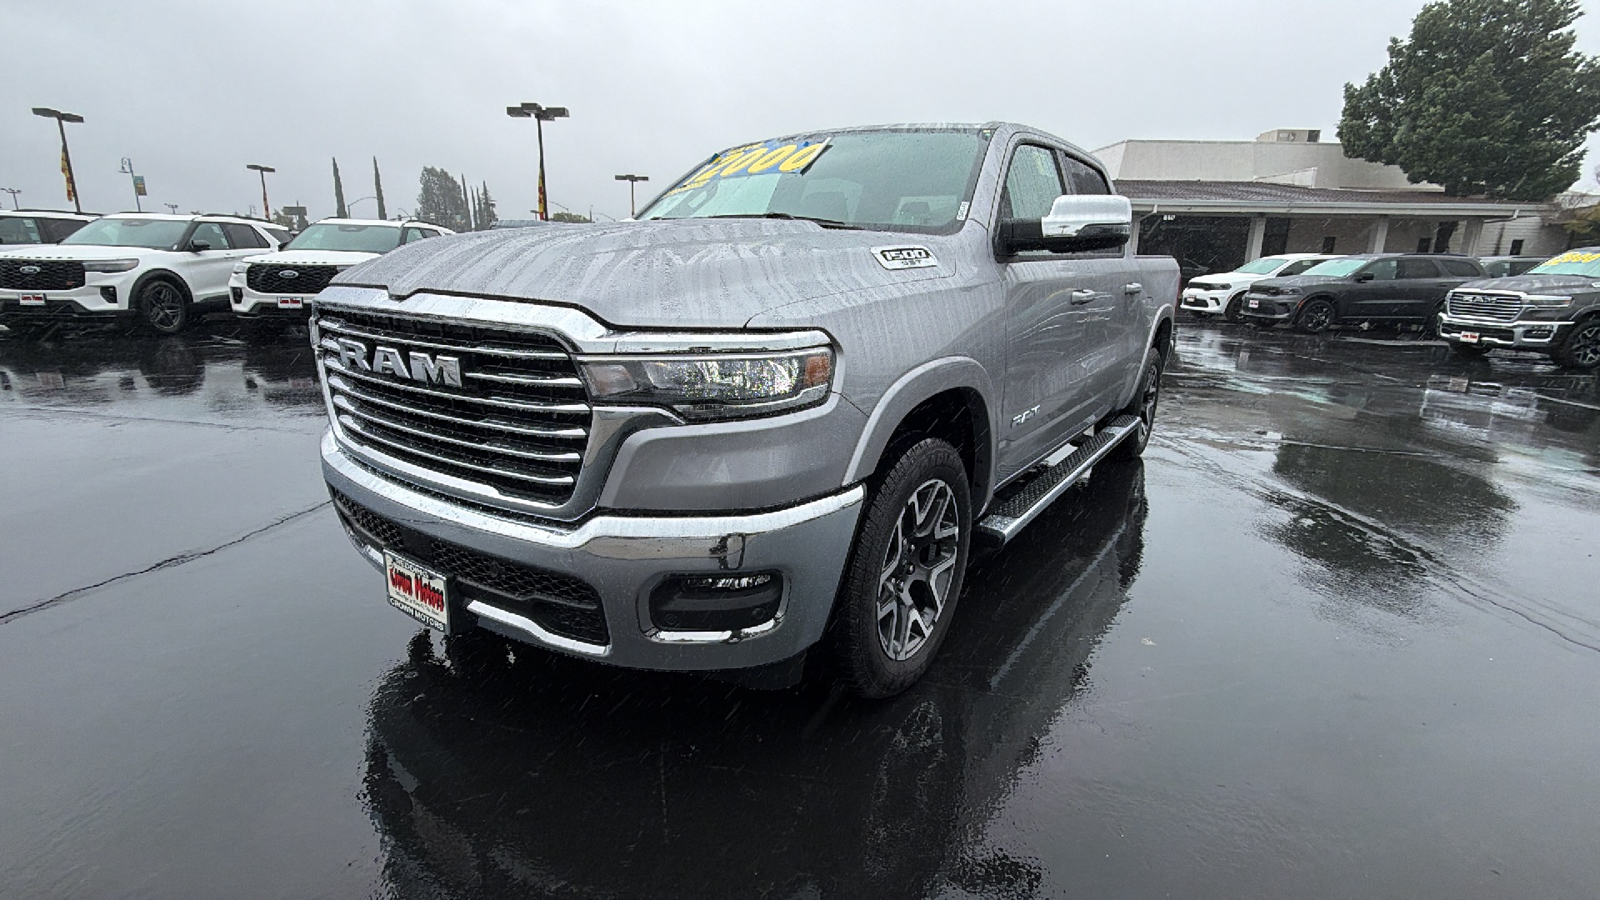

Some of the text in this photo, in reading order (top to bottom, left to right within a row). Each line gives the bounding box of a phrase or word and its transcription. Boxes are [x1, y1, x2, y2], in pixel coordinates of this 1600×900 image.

[882, 250, 927, 260] 1500
[338, 337, 462, 388] RAM
[389, 597, 414, 616] CROWN
[414, 610, 445, 631] MOTORS
